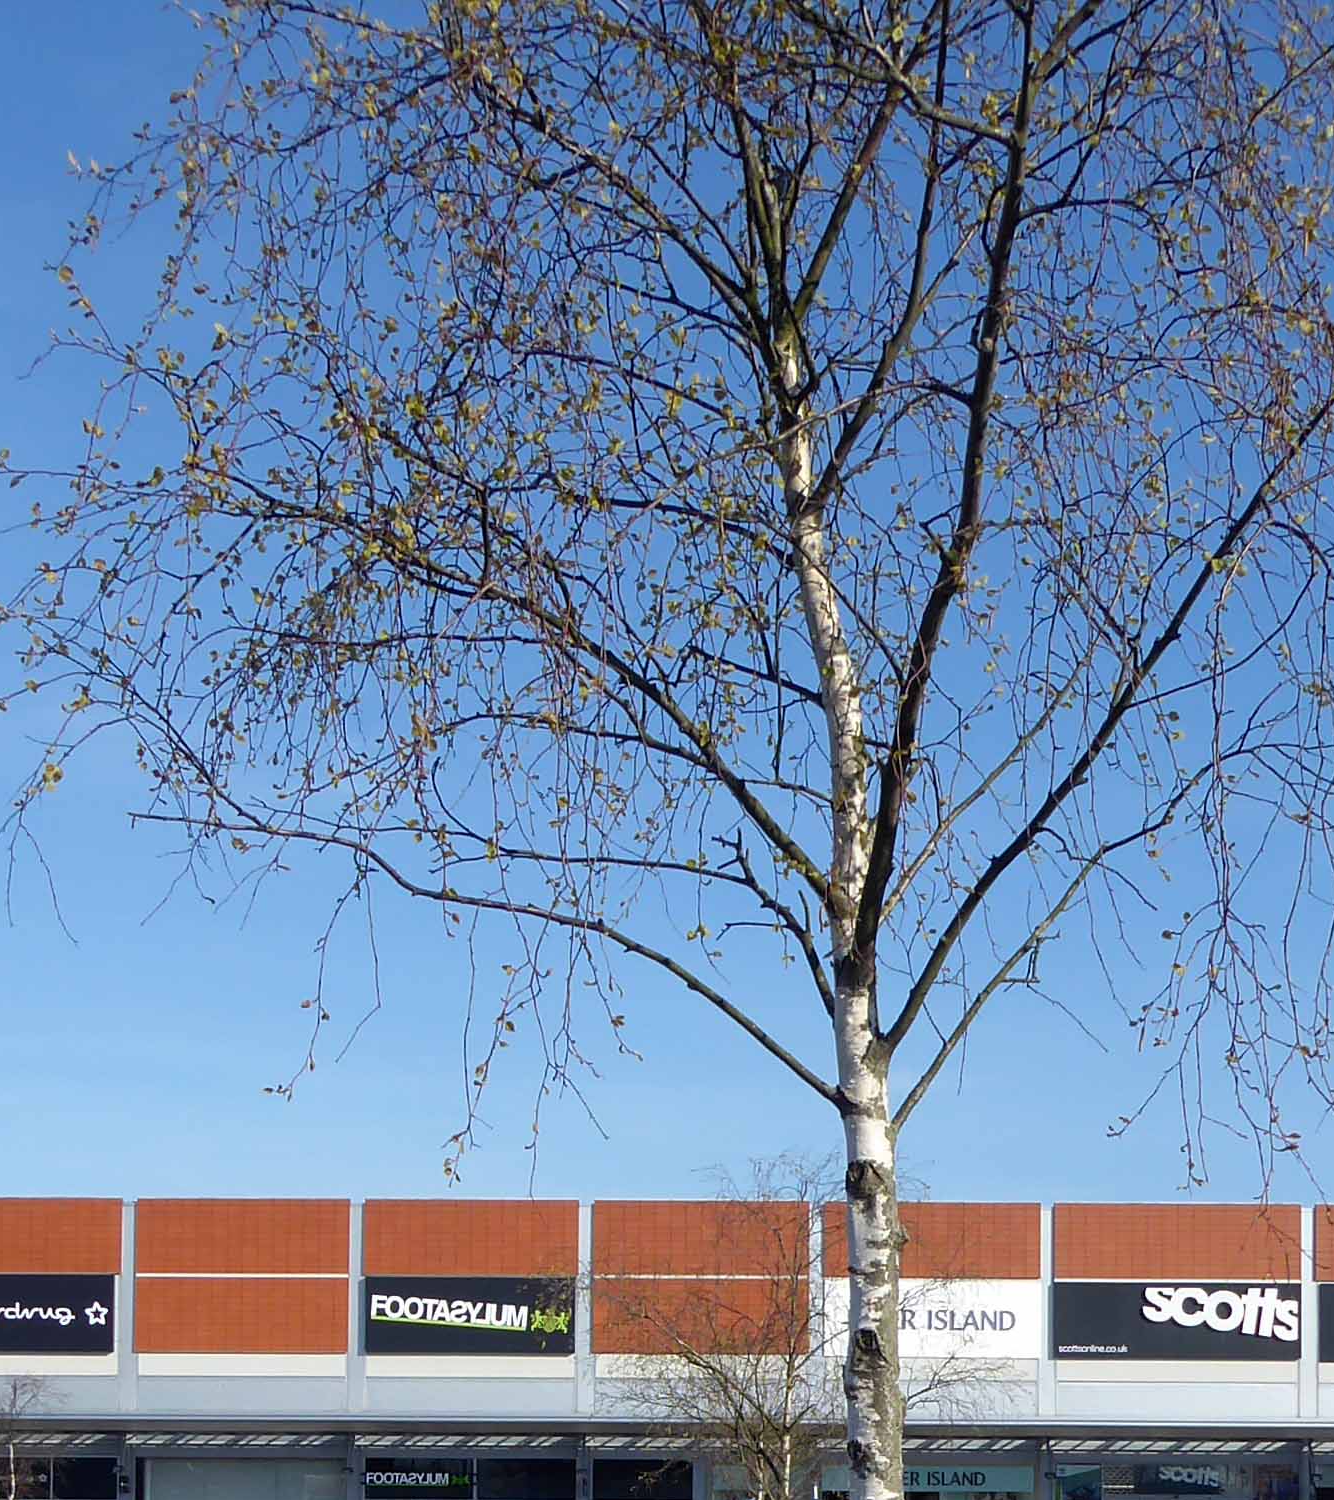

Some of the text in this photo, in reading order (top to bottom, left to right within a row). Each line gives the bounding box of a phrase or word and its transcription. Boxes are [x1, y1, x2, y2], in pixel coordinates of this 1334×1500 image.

[370, 1294, 528, 1331] FOOTASYLUM
[927, 1309, 1016, 1331] ISLAND
[1142, 1287, 1299, 1342] scotts
[366, 1472, 449, 1486] FOOTASYLUM
[927, 1471, 986, 1486] ISLAND
